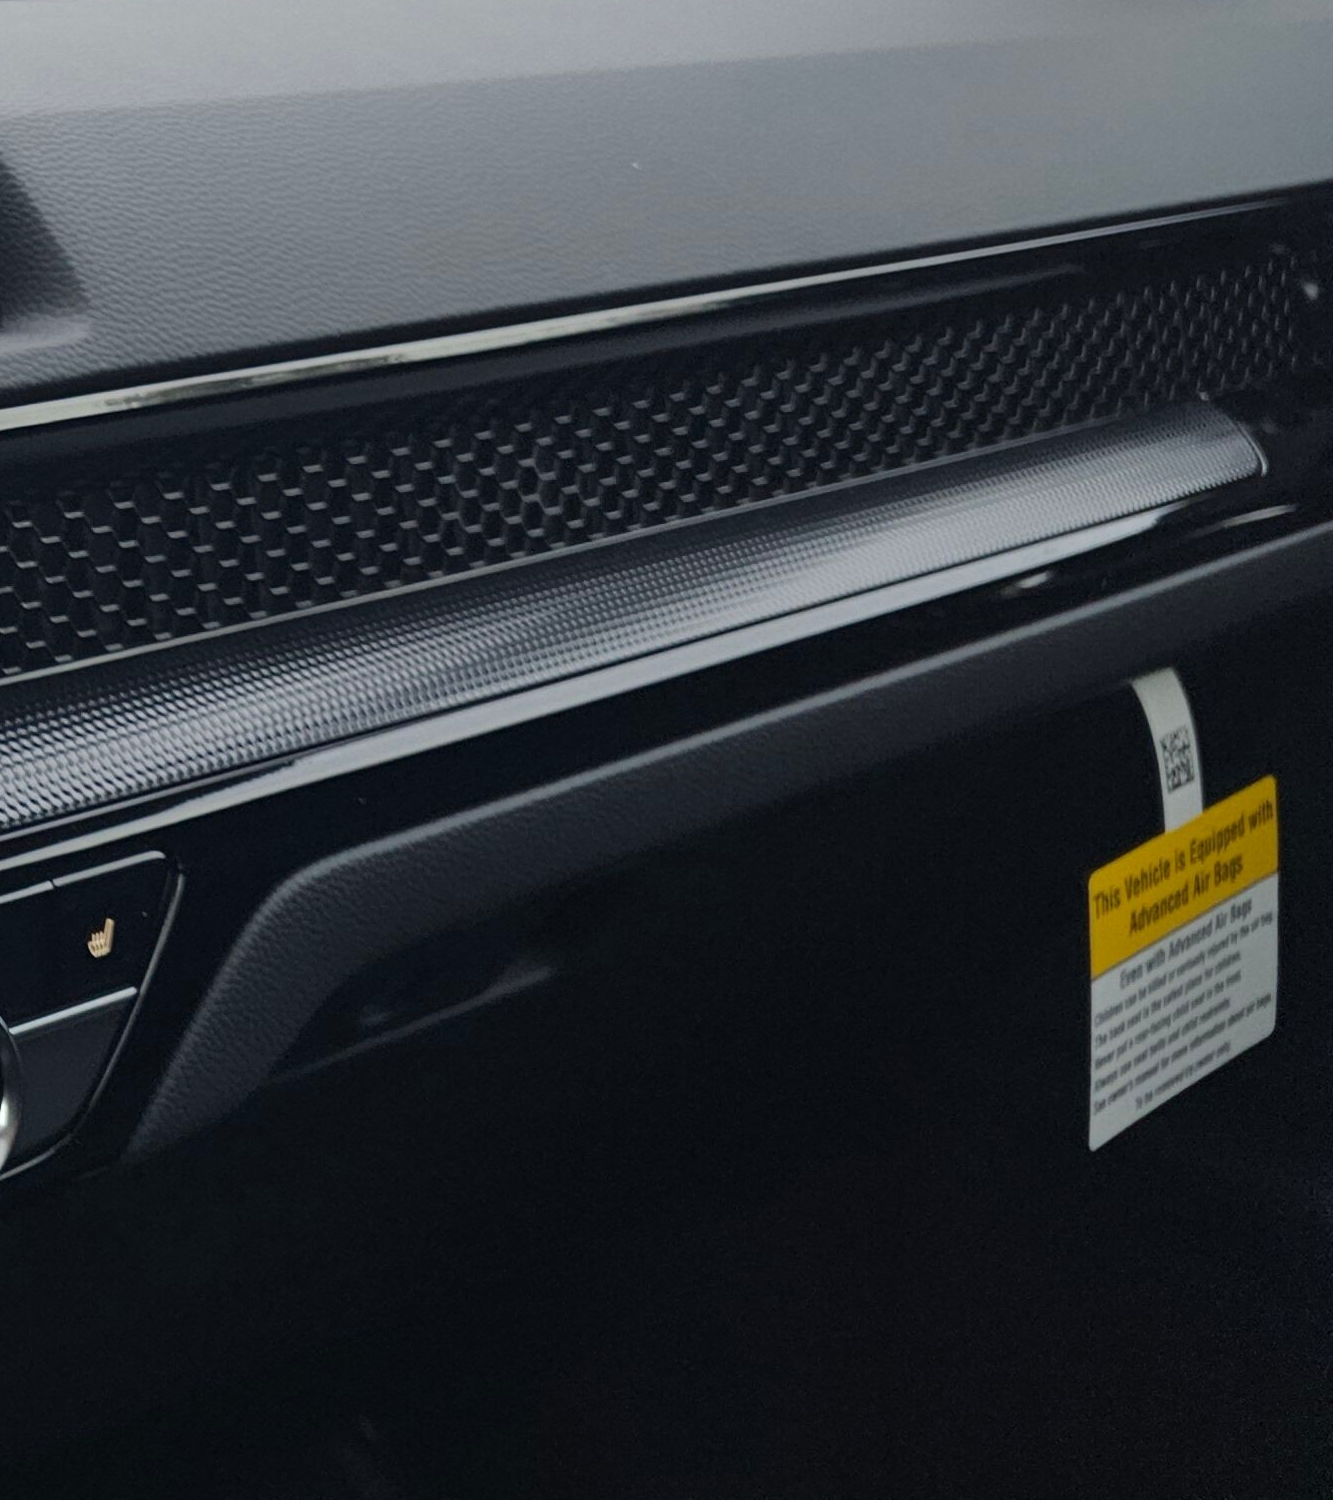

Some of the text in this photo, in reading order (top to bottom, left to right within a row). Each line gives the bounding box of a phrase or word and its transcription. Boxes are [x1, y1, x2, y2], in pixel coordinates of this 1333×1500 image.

[1092, 799, 1274, 919] This Vehicle is Equipped with
[1129, 855, 1244, 936] Advanced Air Bags
